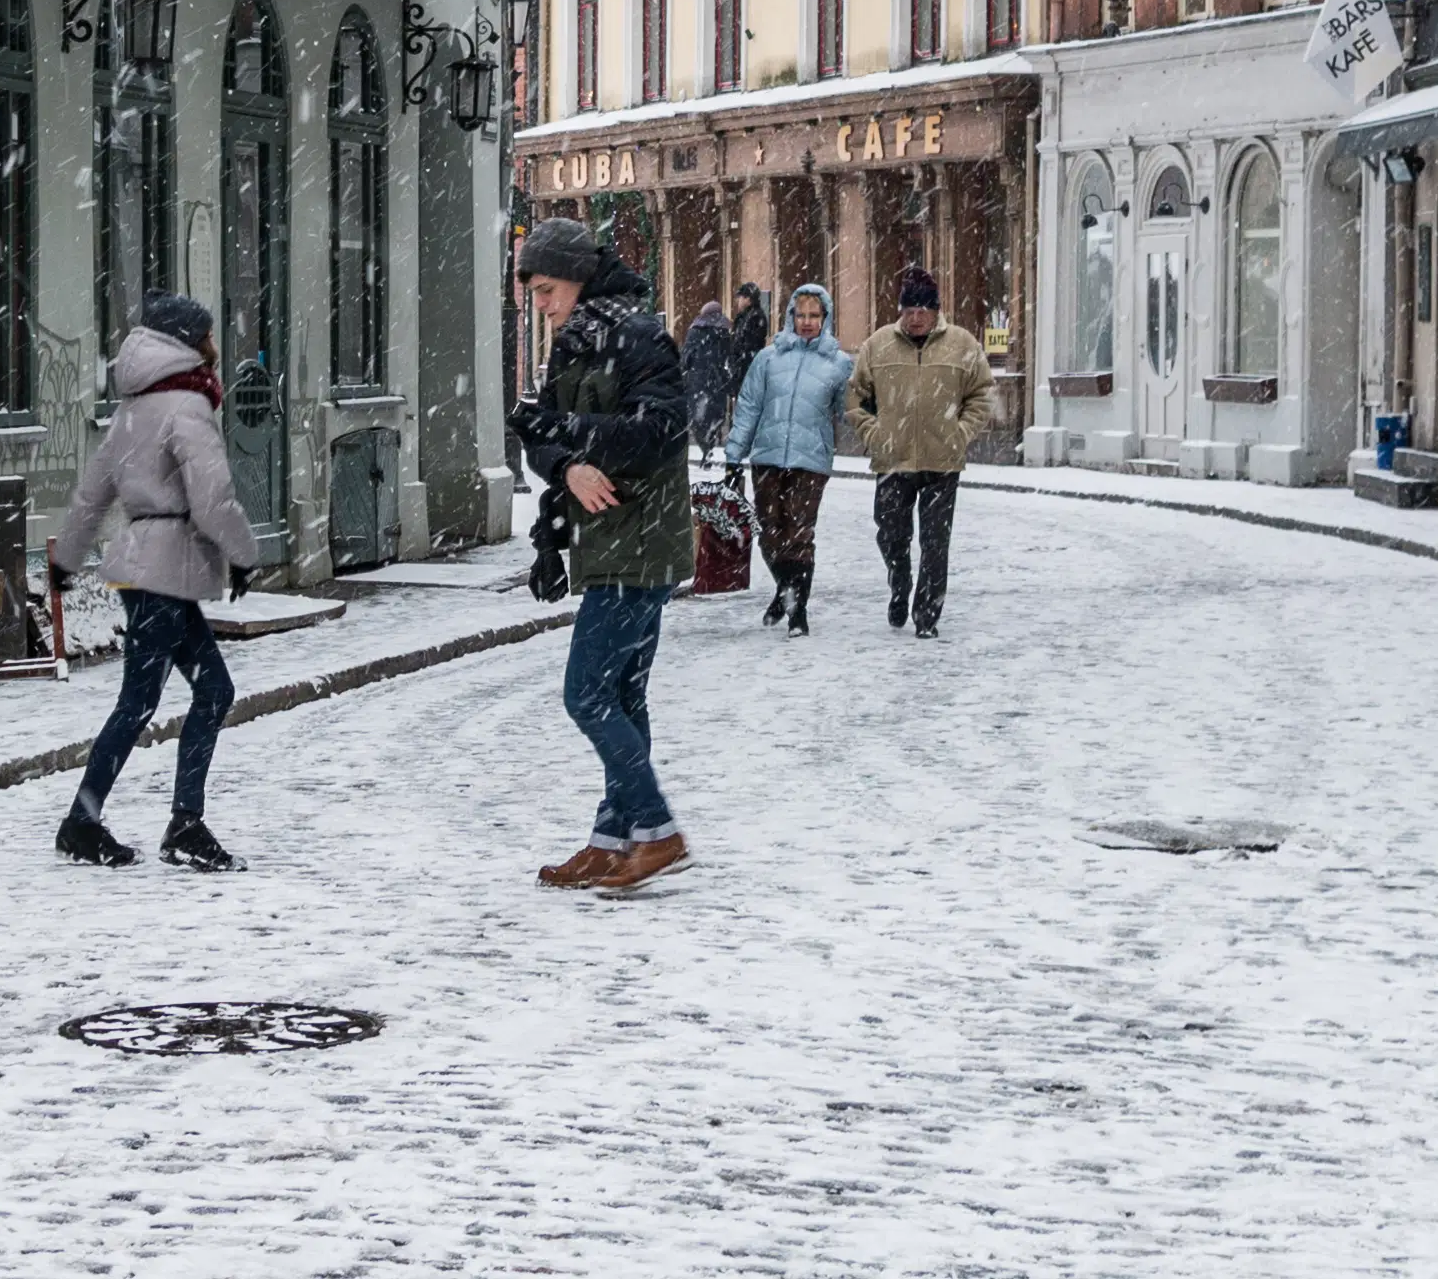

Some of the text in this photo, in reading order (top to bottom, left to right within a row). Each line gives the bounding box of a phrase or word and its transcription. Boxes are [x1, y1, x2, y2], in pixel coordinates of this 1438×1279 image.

[1325, 28, 1379, 79] KAFĒ
[552, 150, 637, 191] CUBA
[836, 114, 943, 163] CAFE
